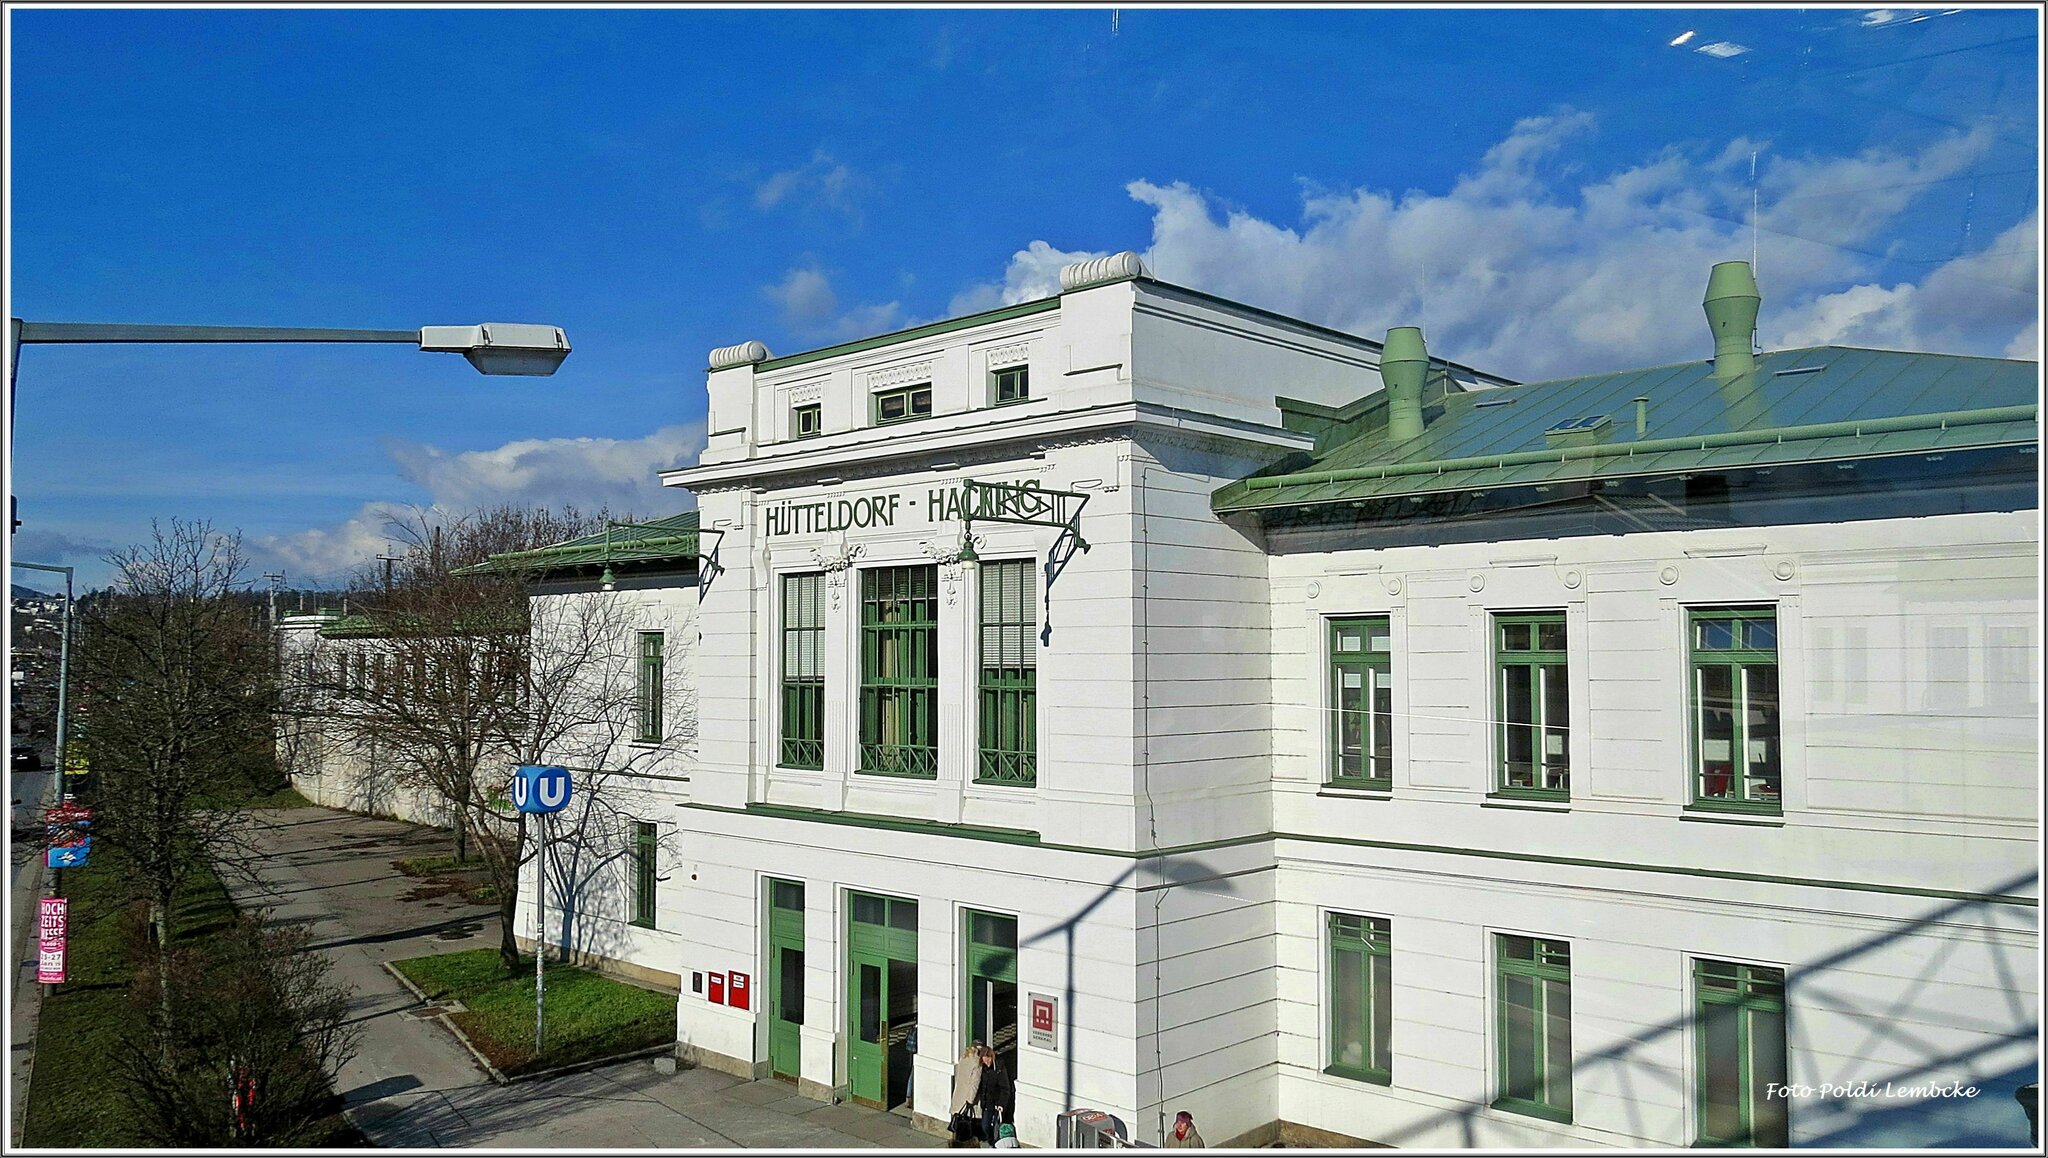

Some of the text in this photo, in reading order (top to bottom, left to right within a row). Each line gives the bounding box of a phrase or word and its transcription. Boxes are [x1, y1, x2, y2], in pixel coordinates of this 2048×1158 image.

[765, 494, 900, 536] HÜTTELDORF
[928, 479, 1042, 522] HACKING
[539, 777, 565, 807] U
